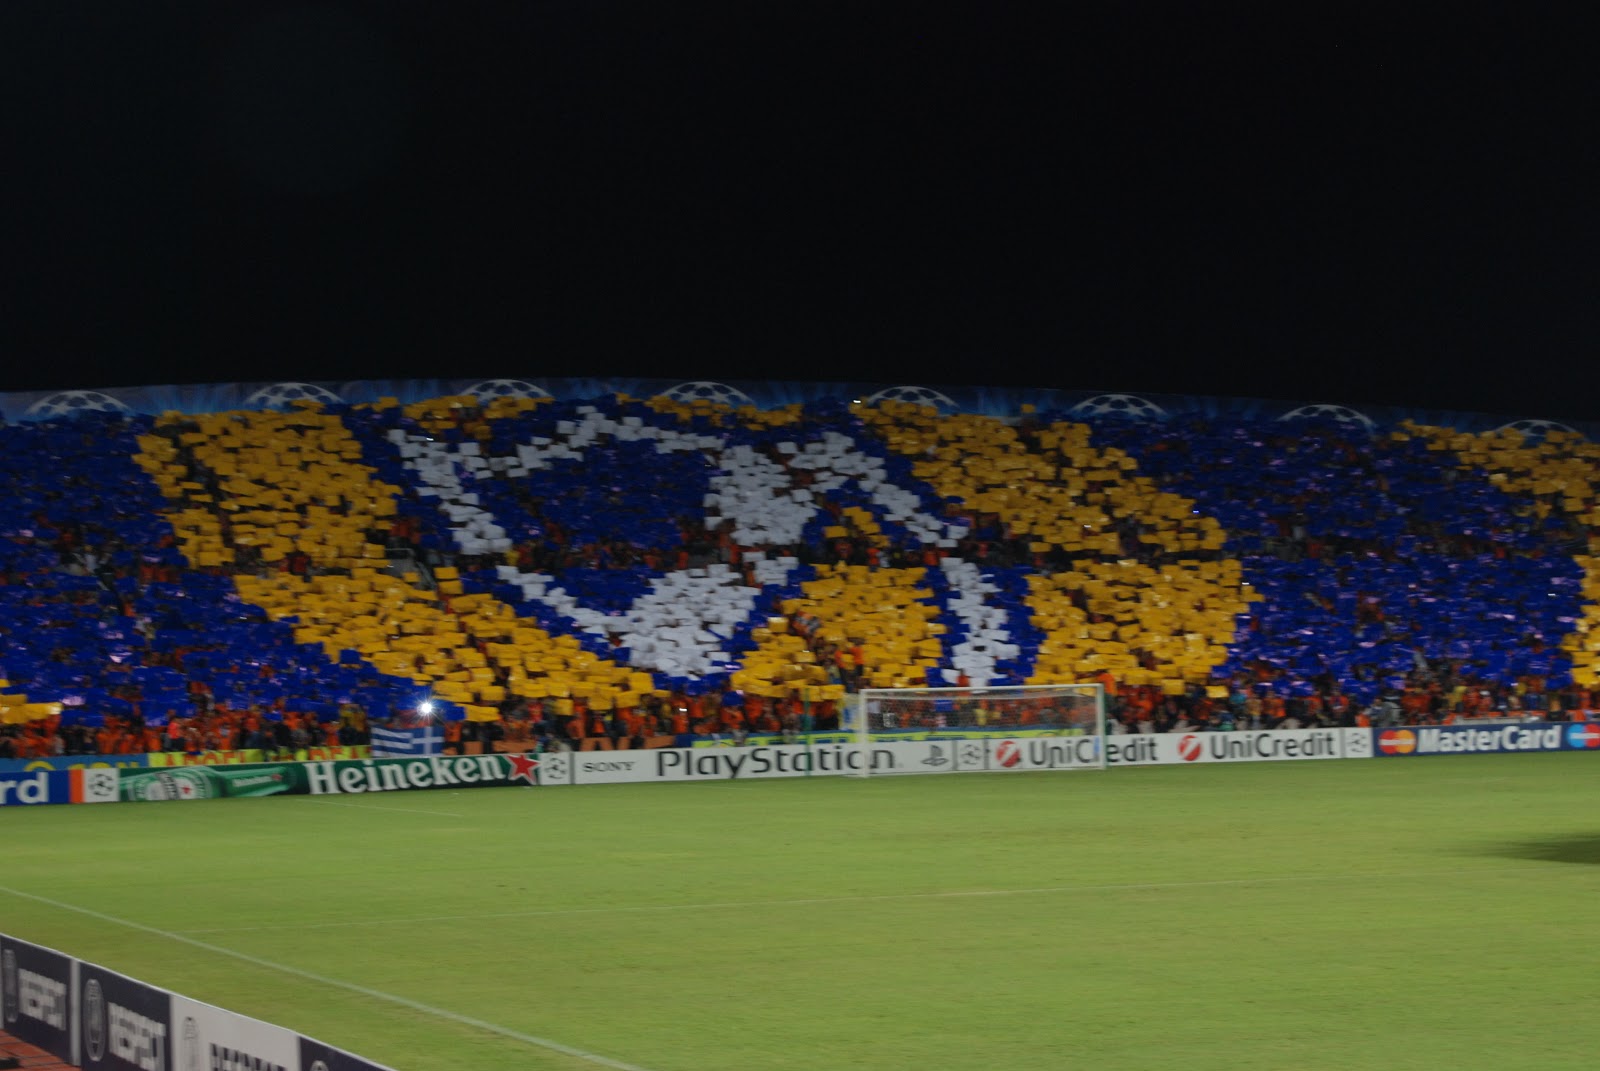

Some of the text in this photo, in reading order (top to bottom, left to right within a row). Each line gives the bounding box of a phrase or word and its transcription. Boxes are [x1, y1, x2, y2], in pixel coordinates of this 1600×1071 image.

[1210, 733, 1336, 759] UniCredit
[1416, 725, 1562, 753] MasterCard
[303, 754, 506, 795] Heineken
[583, 761, 635, 773] SONY
